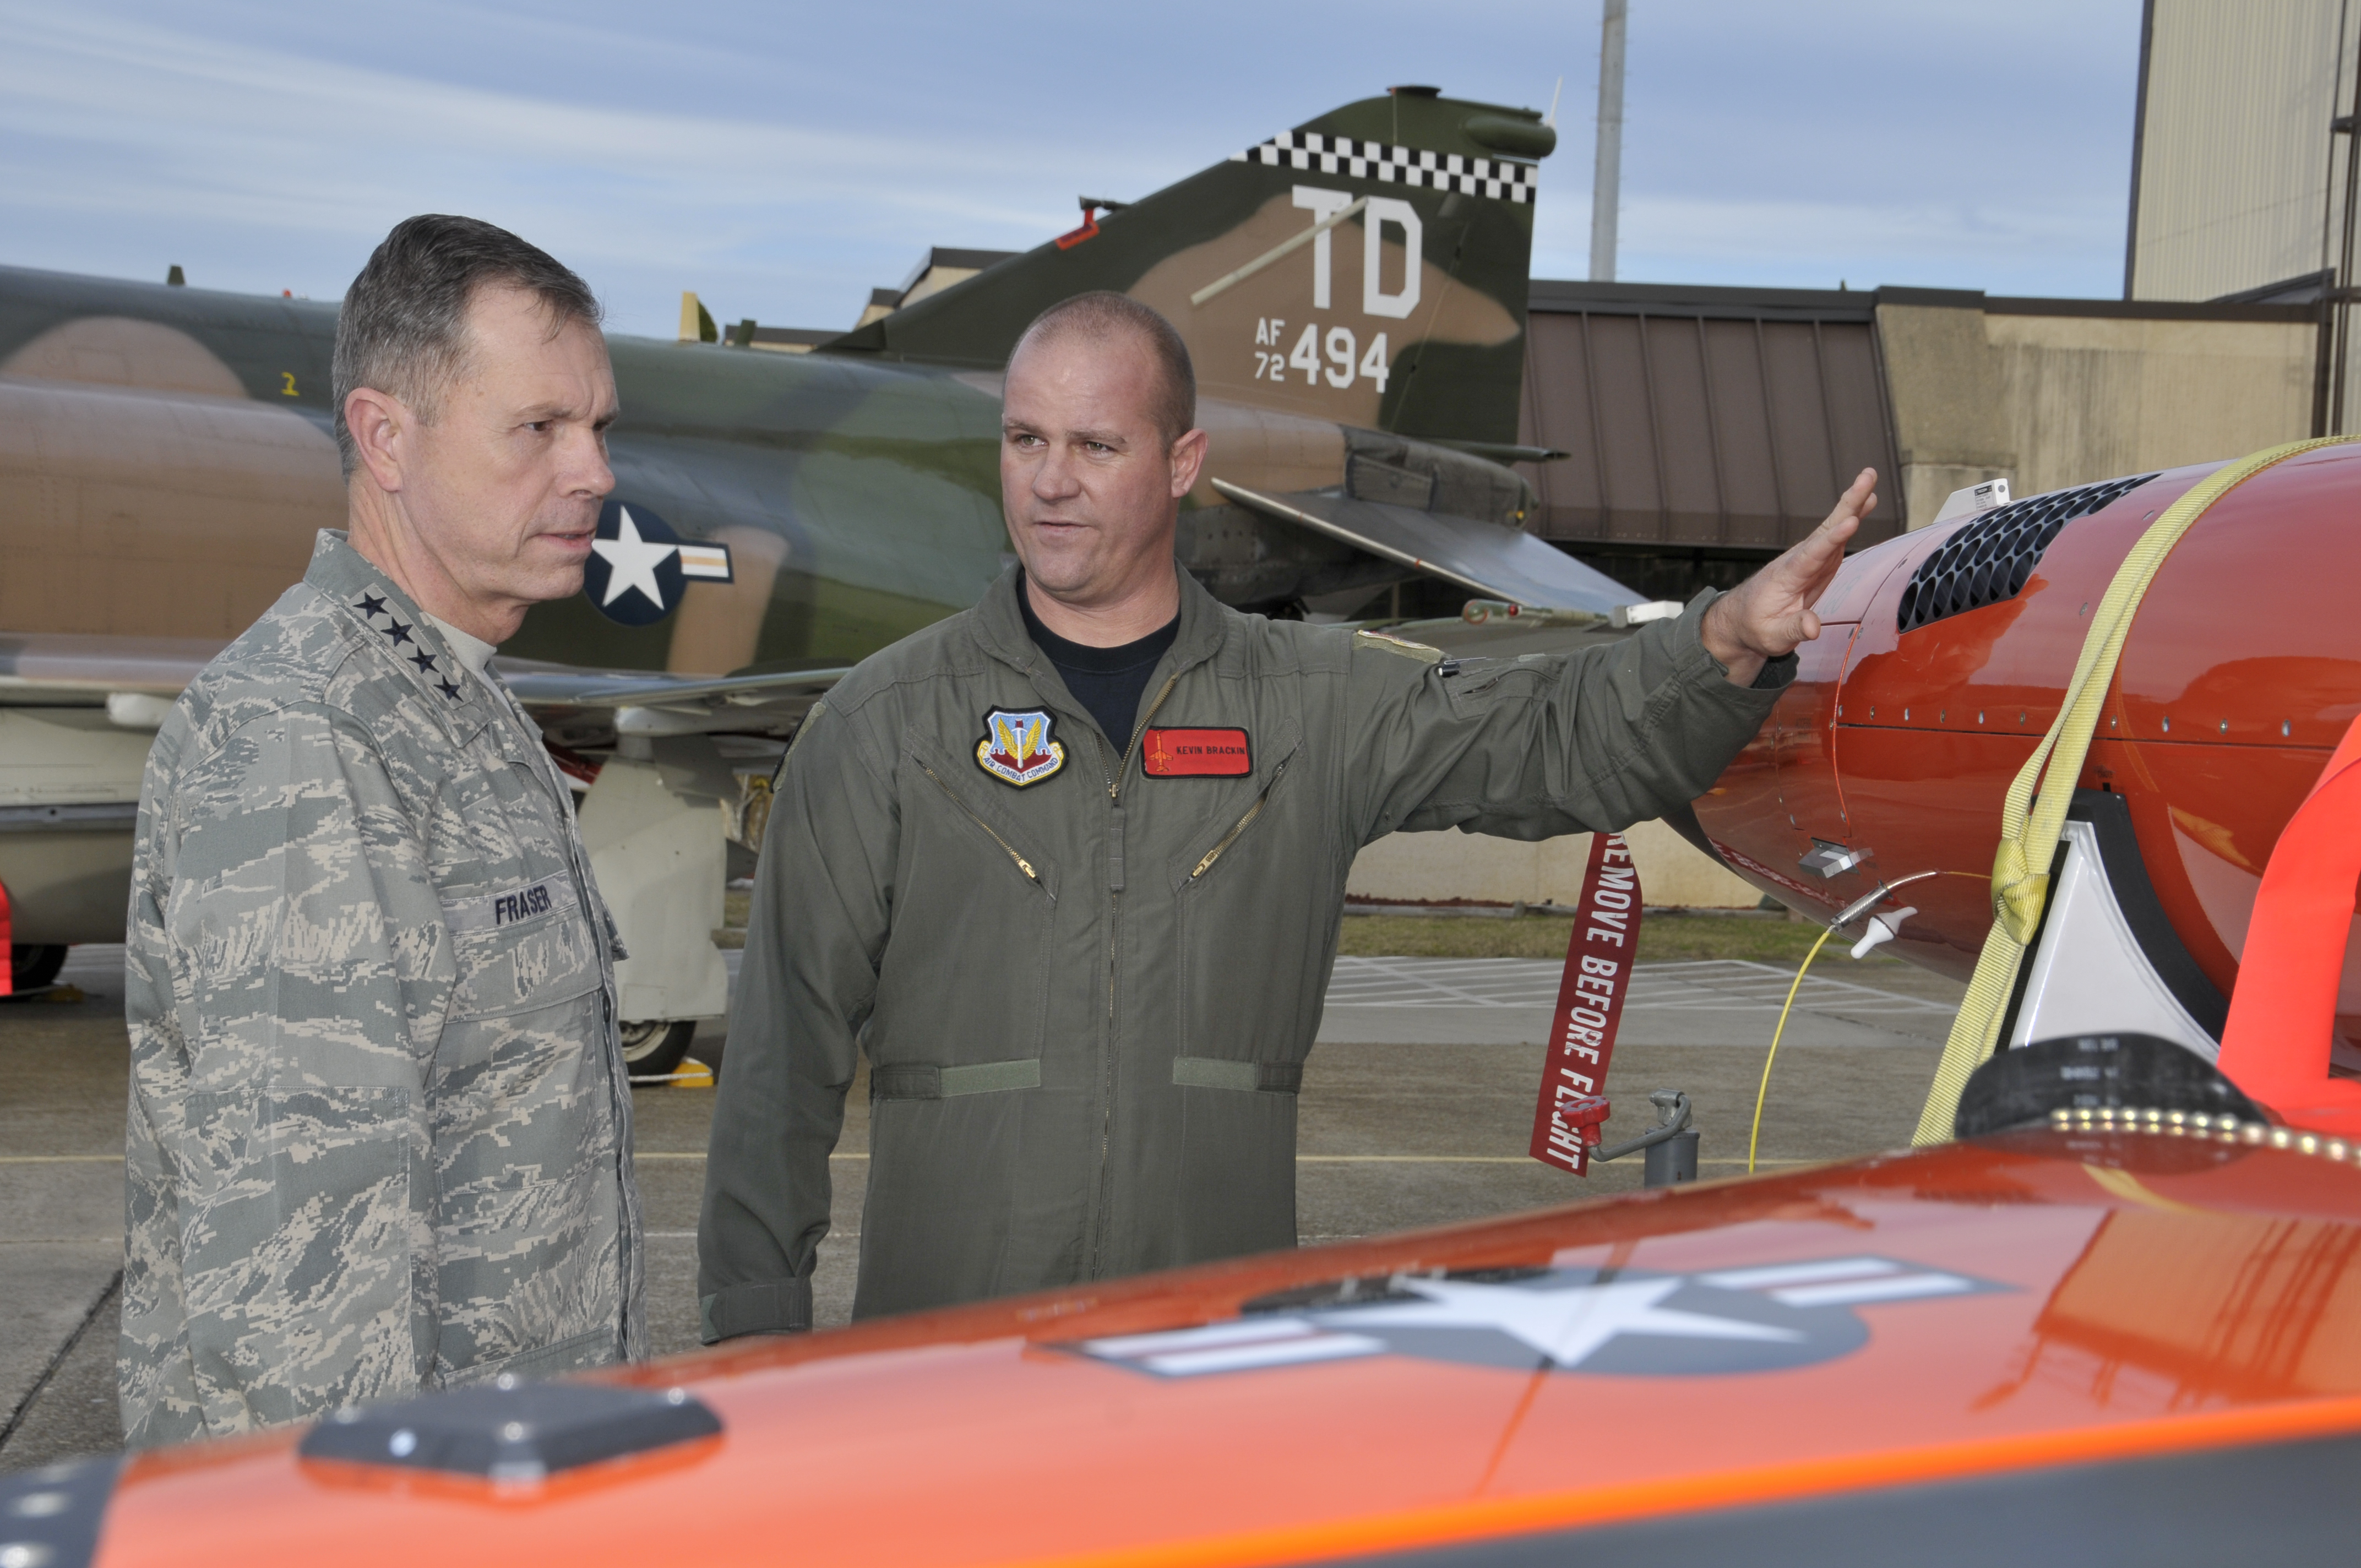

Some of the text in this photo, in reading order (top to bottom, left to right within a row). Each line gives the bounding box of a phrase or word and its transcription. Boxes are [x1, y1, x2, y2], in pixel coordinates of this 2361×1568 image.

[1292, 183, 1423, 320] TD
[1254, 317, 1286, 346] AF
[1254, 322, 1390, 394] 72 494
[281, 371, 300, 396] 2
[1176, 745, 1246, 755] KEVIN BRACKIN
[983, 756, 1059, 782] AIR COMBAT COMMAND
[495, 884, 552, 925] FRASER
[1564, 955, 1618, 1065] BEFORE
